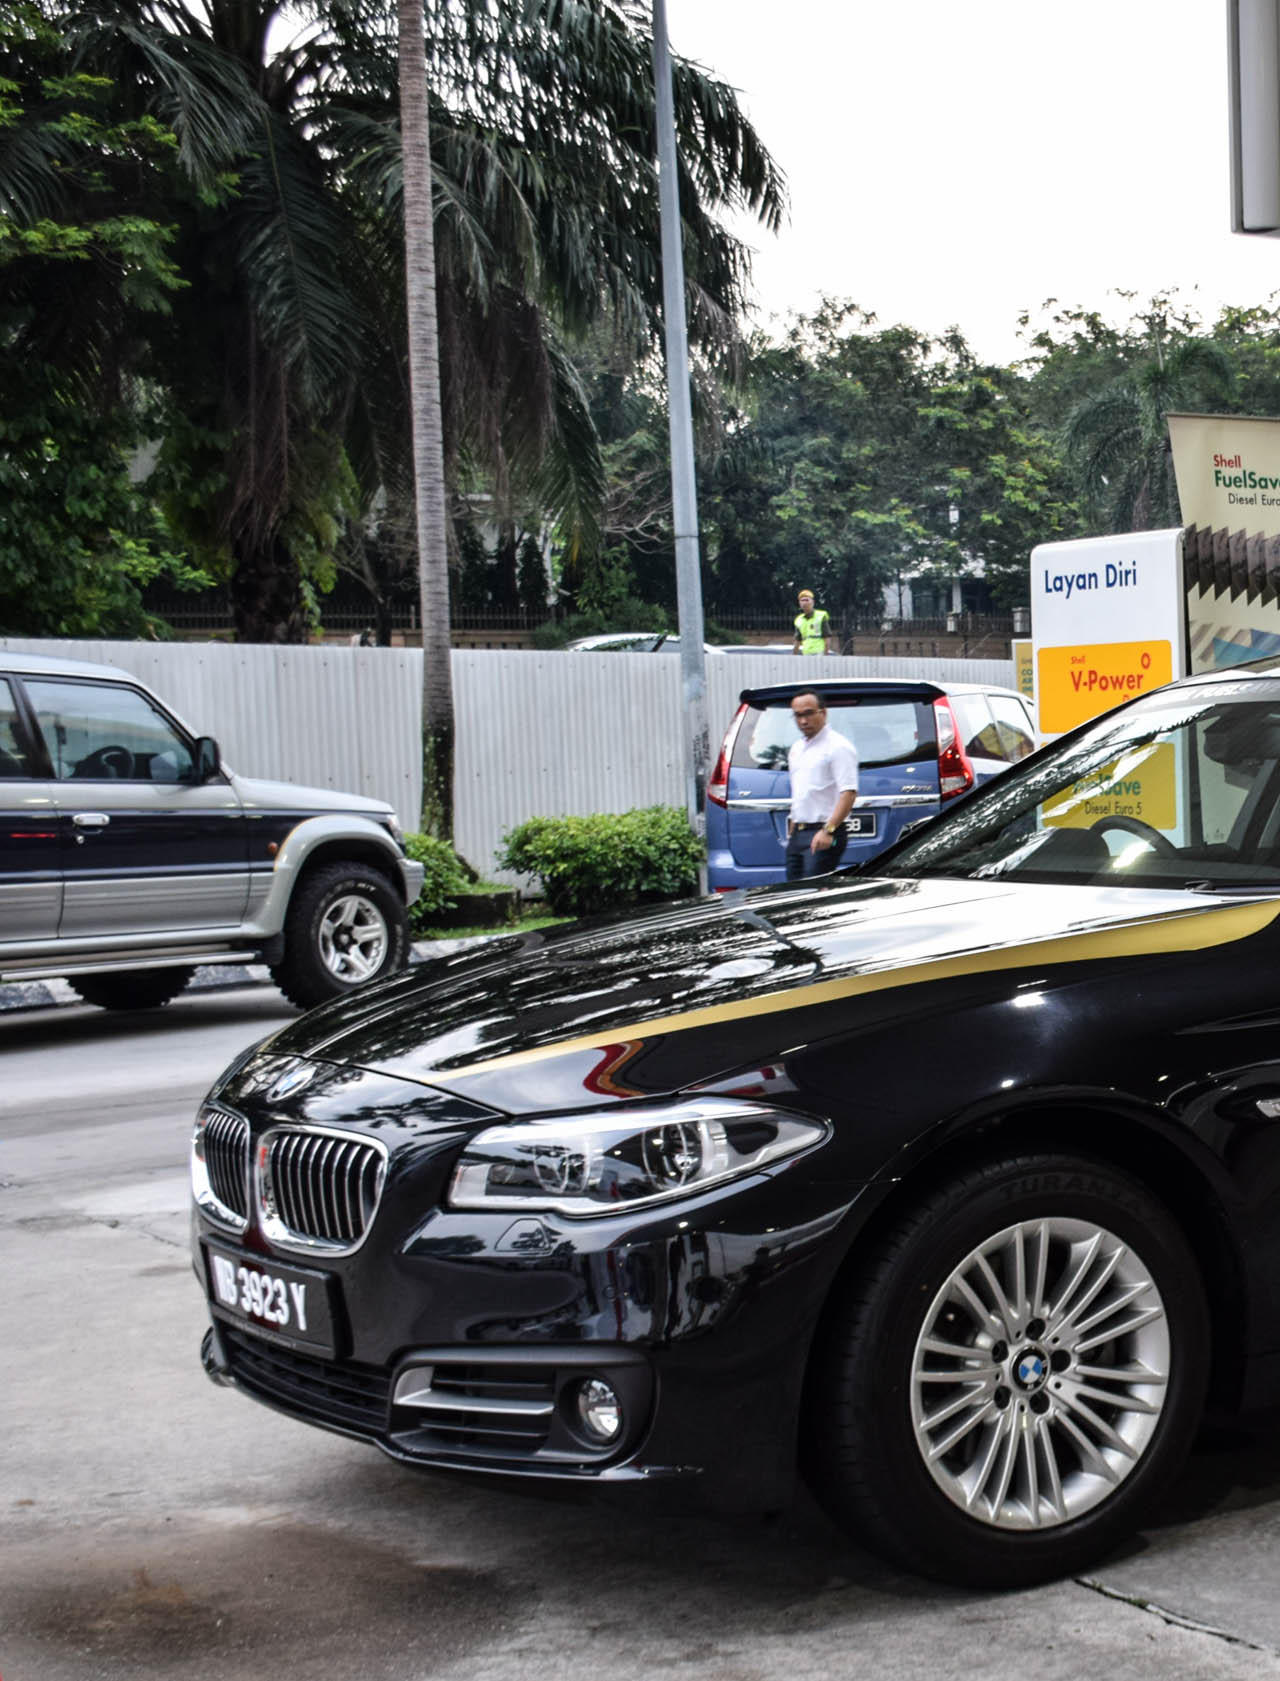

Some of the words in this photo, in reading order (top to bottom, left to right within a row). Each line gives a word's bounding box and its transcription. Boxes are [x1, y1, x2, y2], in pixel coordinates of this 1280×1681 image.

[1213, 454, 1241, 468] Shell
[1228, 492, 1257, 505] Diesel
[1045, 569, 1098, 600] Layan
[1105, 560, 1136, 588] Diri
[1070, 669, 1144, 693] V-Power
[1085, 801, 1112, 815] Diesel
[1114, 801, 1134, 816] Euro
[1136, 803, 1142, 816] 5
[238, 1267, 289, 1325] 3923
[290, 1282, 306, 1331] Y
